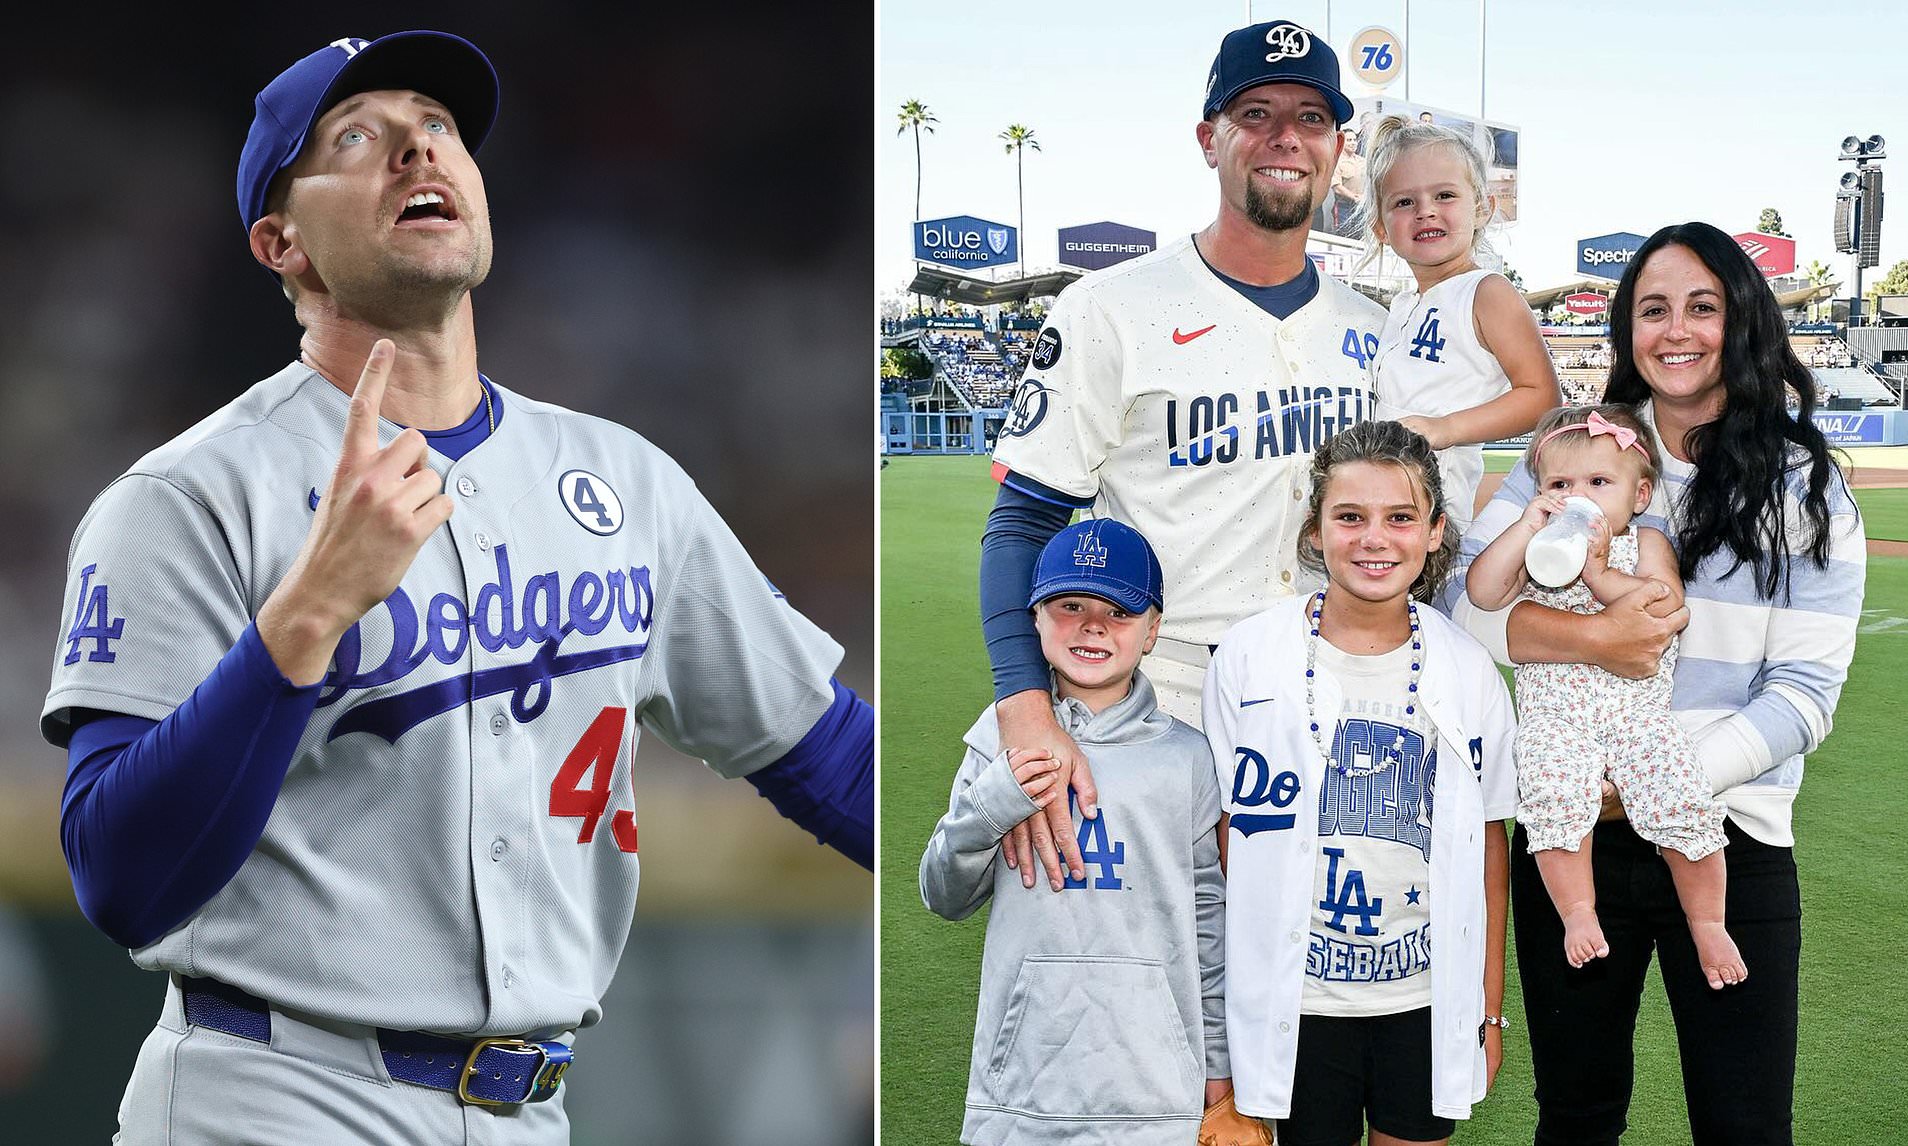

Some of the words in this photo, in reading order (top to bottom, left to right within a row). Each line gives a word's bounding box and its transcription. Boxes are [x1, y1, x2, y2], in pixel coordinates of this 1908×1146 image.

[1361, 44, 1393, 71] 76
[923, 224, 981, 248] blue
[933, 250, 988, 261] california
[1065, 242, 1150, 254] GUGGENHEIM
[1568, 300, 1604, 308] Yakult
[1034, 341, 1055, 365] 34
[1409, 307, 1446, 363] LA
[1166, 392, 1239, 467] LOS
[573, 477, 614, 526] 4
[1073, 530, 1108, 568] LA
[63, 563, 126, 666] LA
[315, 543, 654, 723] Dodgers
[549, 705, 638, 853] 4
[1319, 846, 1383, 936] LA
